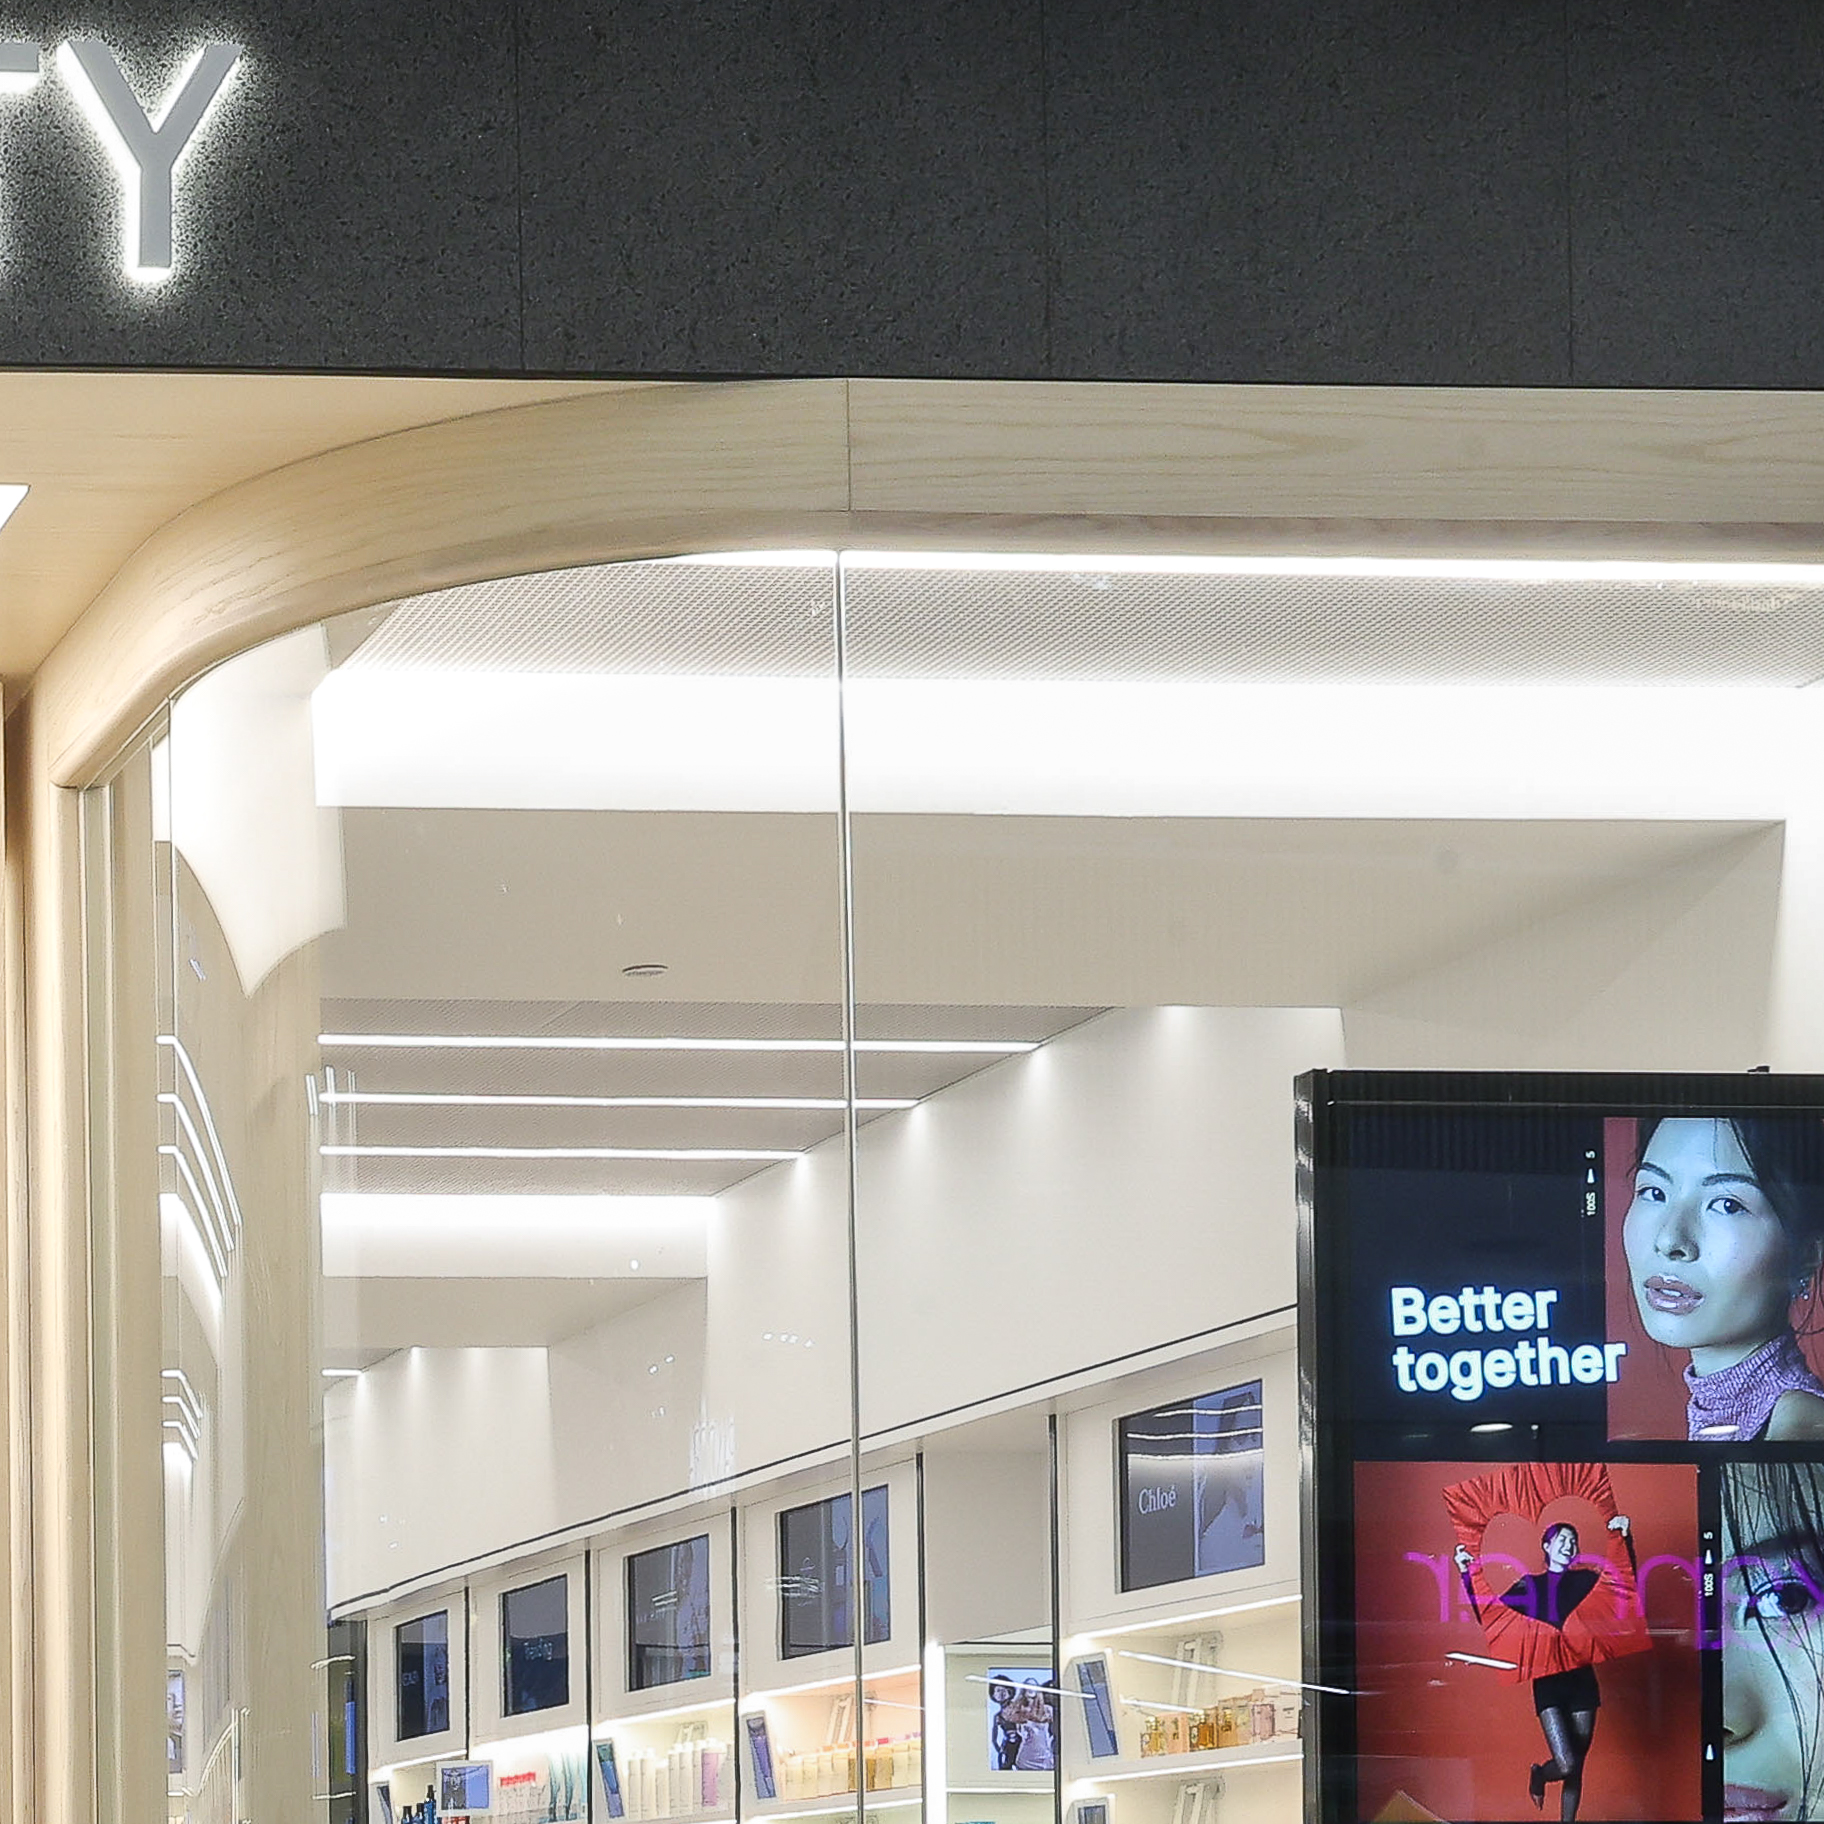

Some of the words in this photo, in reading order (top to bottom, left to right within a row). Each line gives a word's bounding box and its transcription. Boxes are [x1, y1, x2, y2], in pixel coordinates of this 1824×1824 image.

[1391, 1286, 1557, 1336] Better
[1392, 1337, 1626, 1401] together
[1139, 1485, 1176, 1514] Chloé
